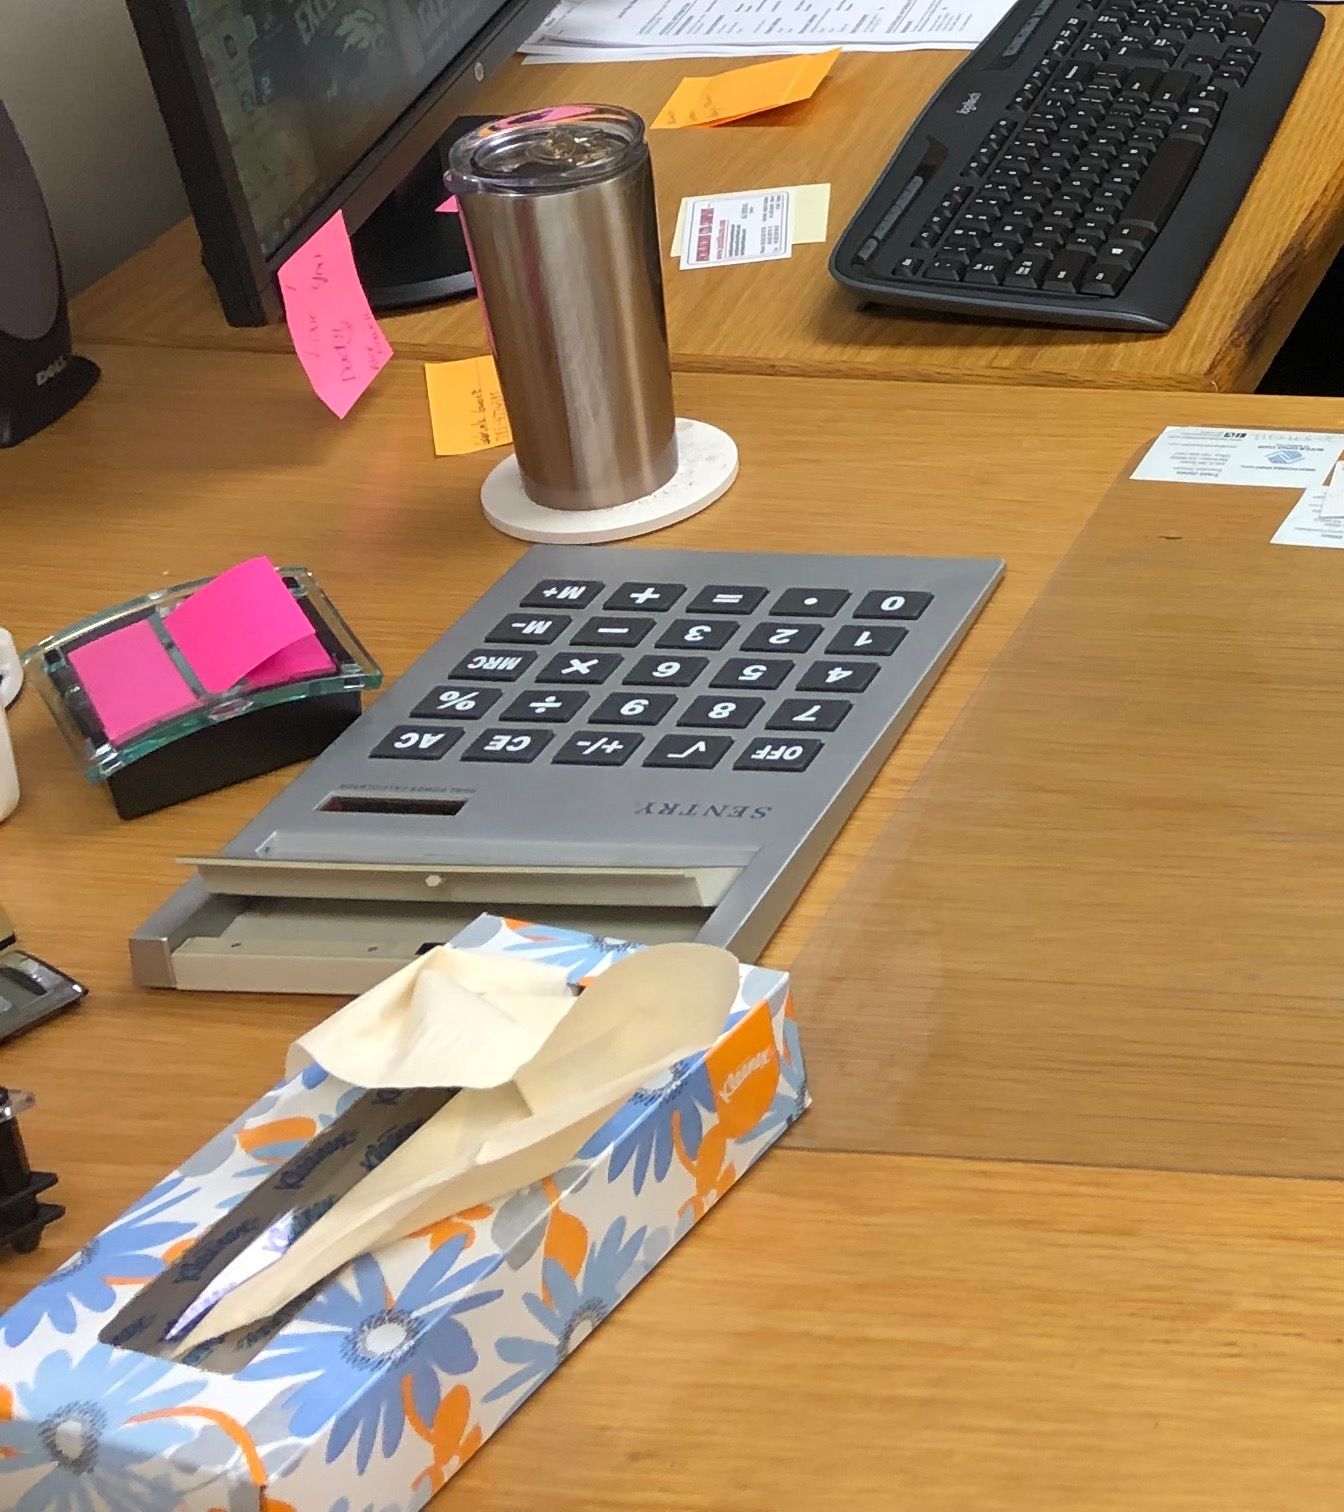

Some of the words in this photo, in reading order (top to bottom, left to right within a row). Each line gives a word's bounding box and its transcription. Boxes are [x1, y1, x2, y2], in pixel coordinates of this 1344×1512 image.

[542, 585, 585, 600] M+
[880, 595, 905, 611] 0
[510, 620, 552, 636] M-
[684, 624, 712, 643] 3
[768, 628, 799, 645] 2
[854, 630, 873, 647] 1
[467, 654, 522, 671] MRC
[652, 661, 680, 678] 6
[738, 664, 767, 681] 5
[824, 667, 854, 683] 4
[620, 698, 650, 716] 9
[707, 702, 738, 719] 8
[792, 703, 821, 721] 7
[393, 731, 446, 750] AC
[483, 733, 532, 752] CE
[575, 737, 624, 754] +/-
[751, 744, 804, 761] OFF
[634, 800, 773, 820] SENTRY
[719, 1049, 771, 1105] Kleenex
